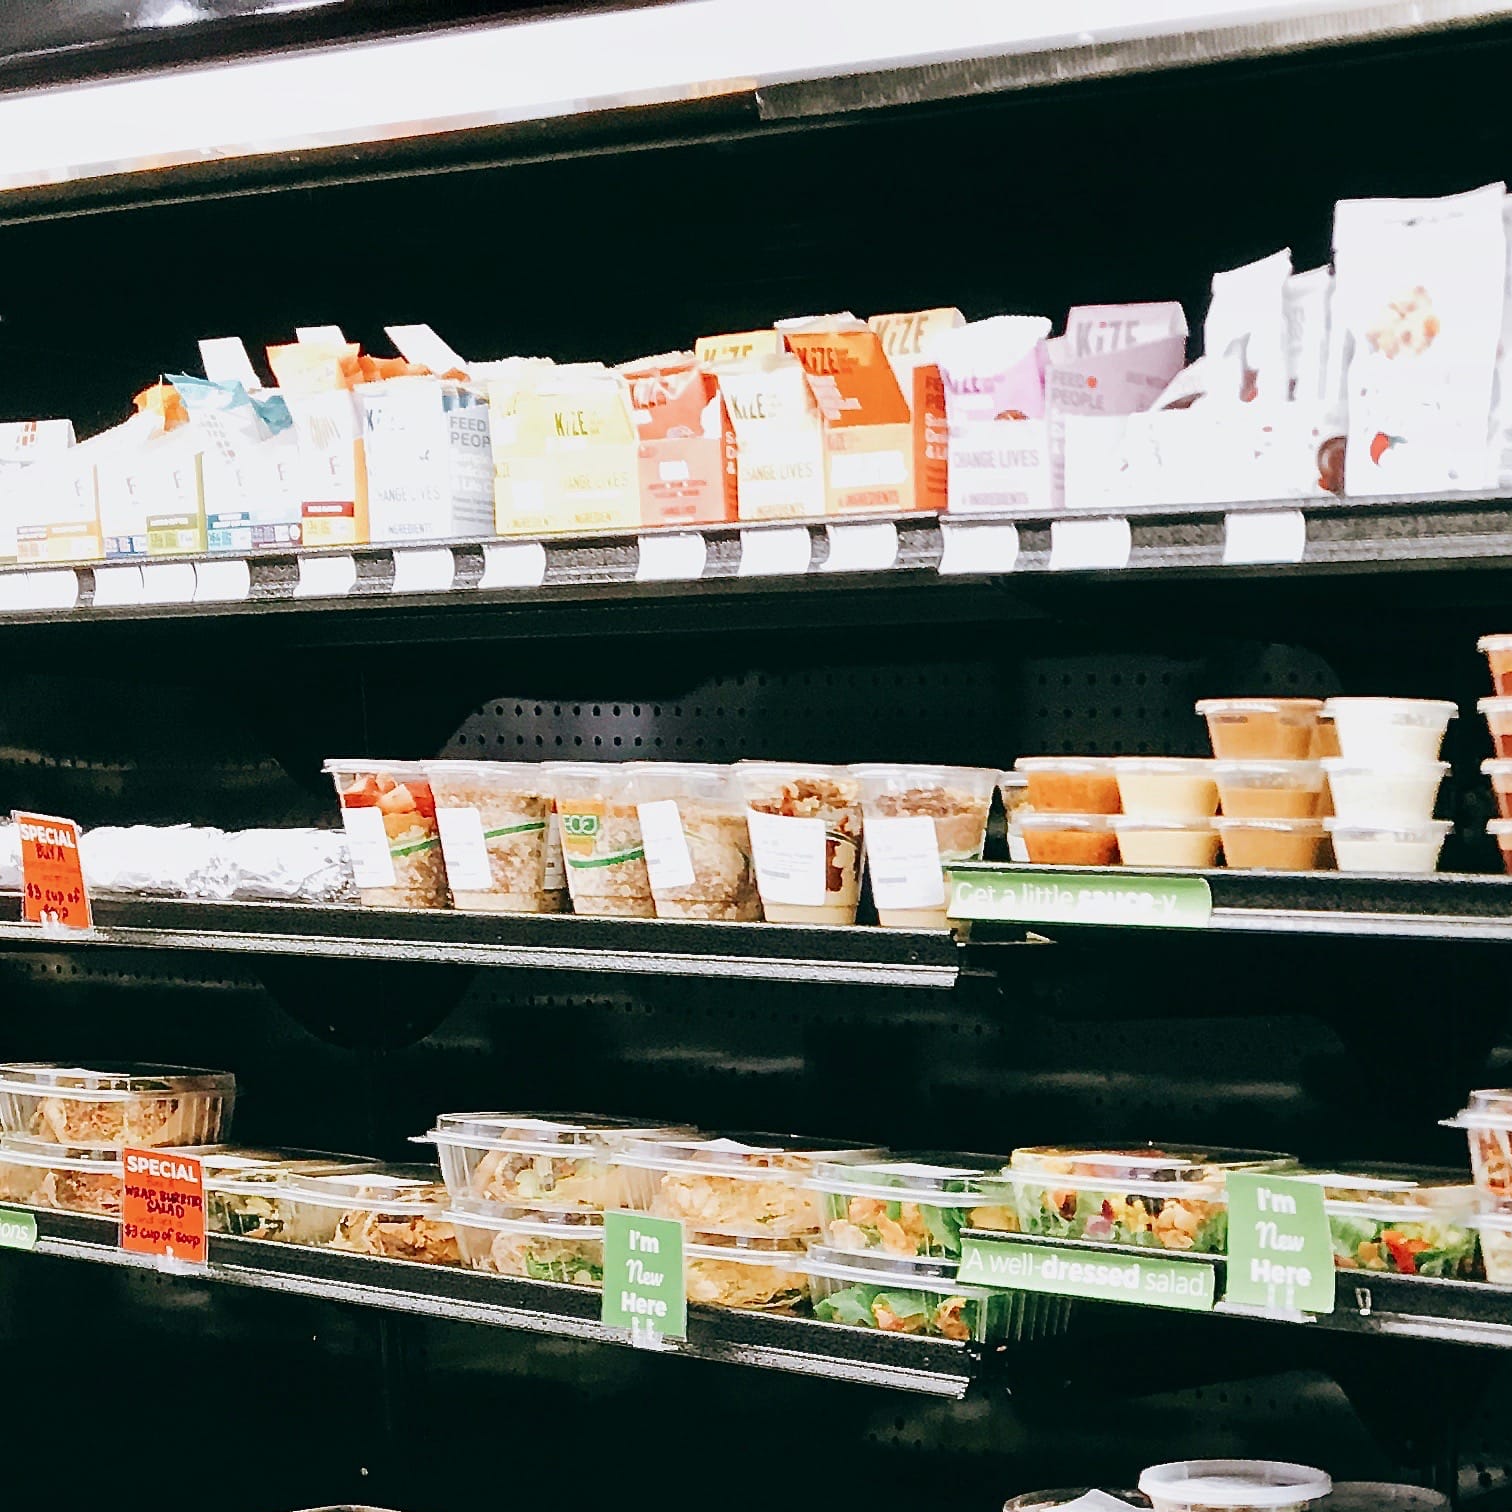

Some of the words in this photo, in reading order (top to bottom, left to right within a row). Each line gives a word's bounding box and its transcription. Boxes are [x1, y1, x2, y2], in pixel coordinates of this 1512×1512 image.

[449, 416, 487, 433] FEED
[999, 448, 1040, 467] LIVES
[21, 823, 76, 848] SPECIAL
[126, 1155, 199, 1184] SPECIAL
[125, 1185, 157, 1201] WRAP
[1256, 1187, 1297, 1214] I'm
[146, 1200, 185, 1219] SALAD
[629, 1229, 659, 1254] I'm
[625, 1259, 664, 1287] New
[965, 1251, 984, 1272] A
[988, 1252, 1140, 1289] well-dressed
[1145, 1271, 1208, 1298] salad.
[1250, 1258, 1313, 1287] Here
[621, 1291, 667, 1317] Here
